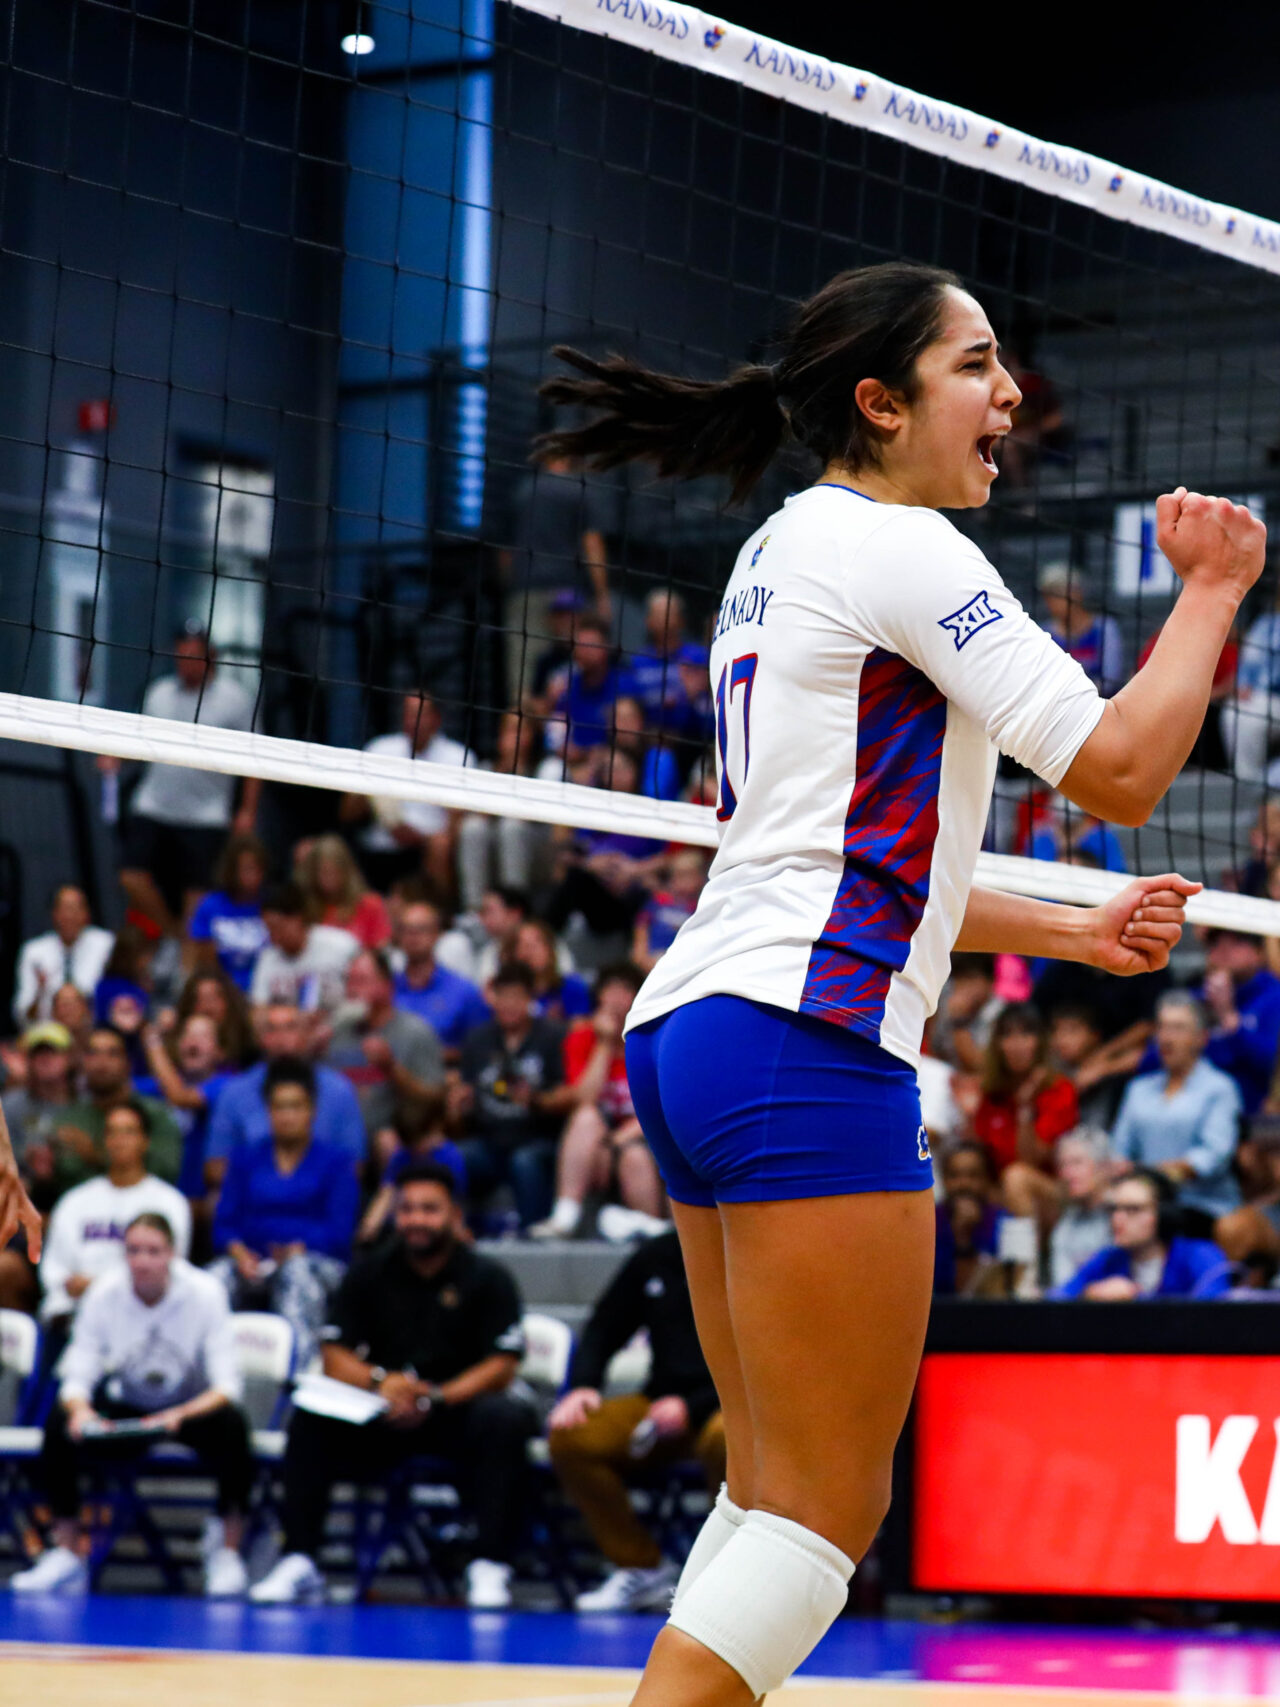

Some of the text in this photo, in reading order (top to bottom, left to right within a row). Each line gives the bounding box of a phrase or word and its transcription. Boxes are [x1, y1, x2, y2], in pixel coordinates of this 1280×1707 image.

[744, 39, 836, 92] KANSAS
[883, 90, 969, 141] KANSAS
[716, 652, 759, 823] 17
